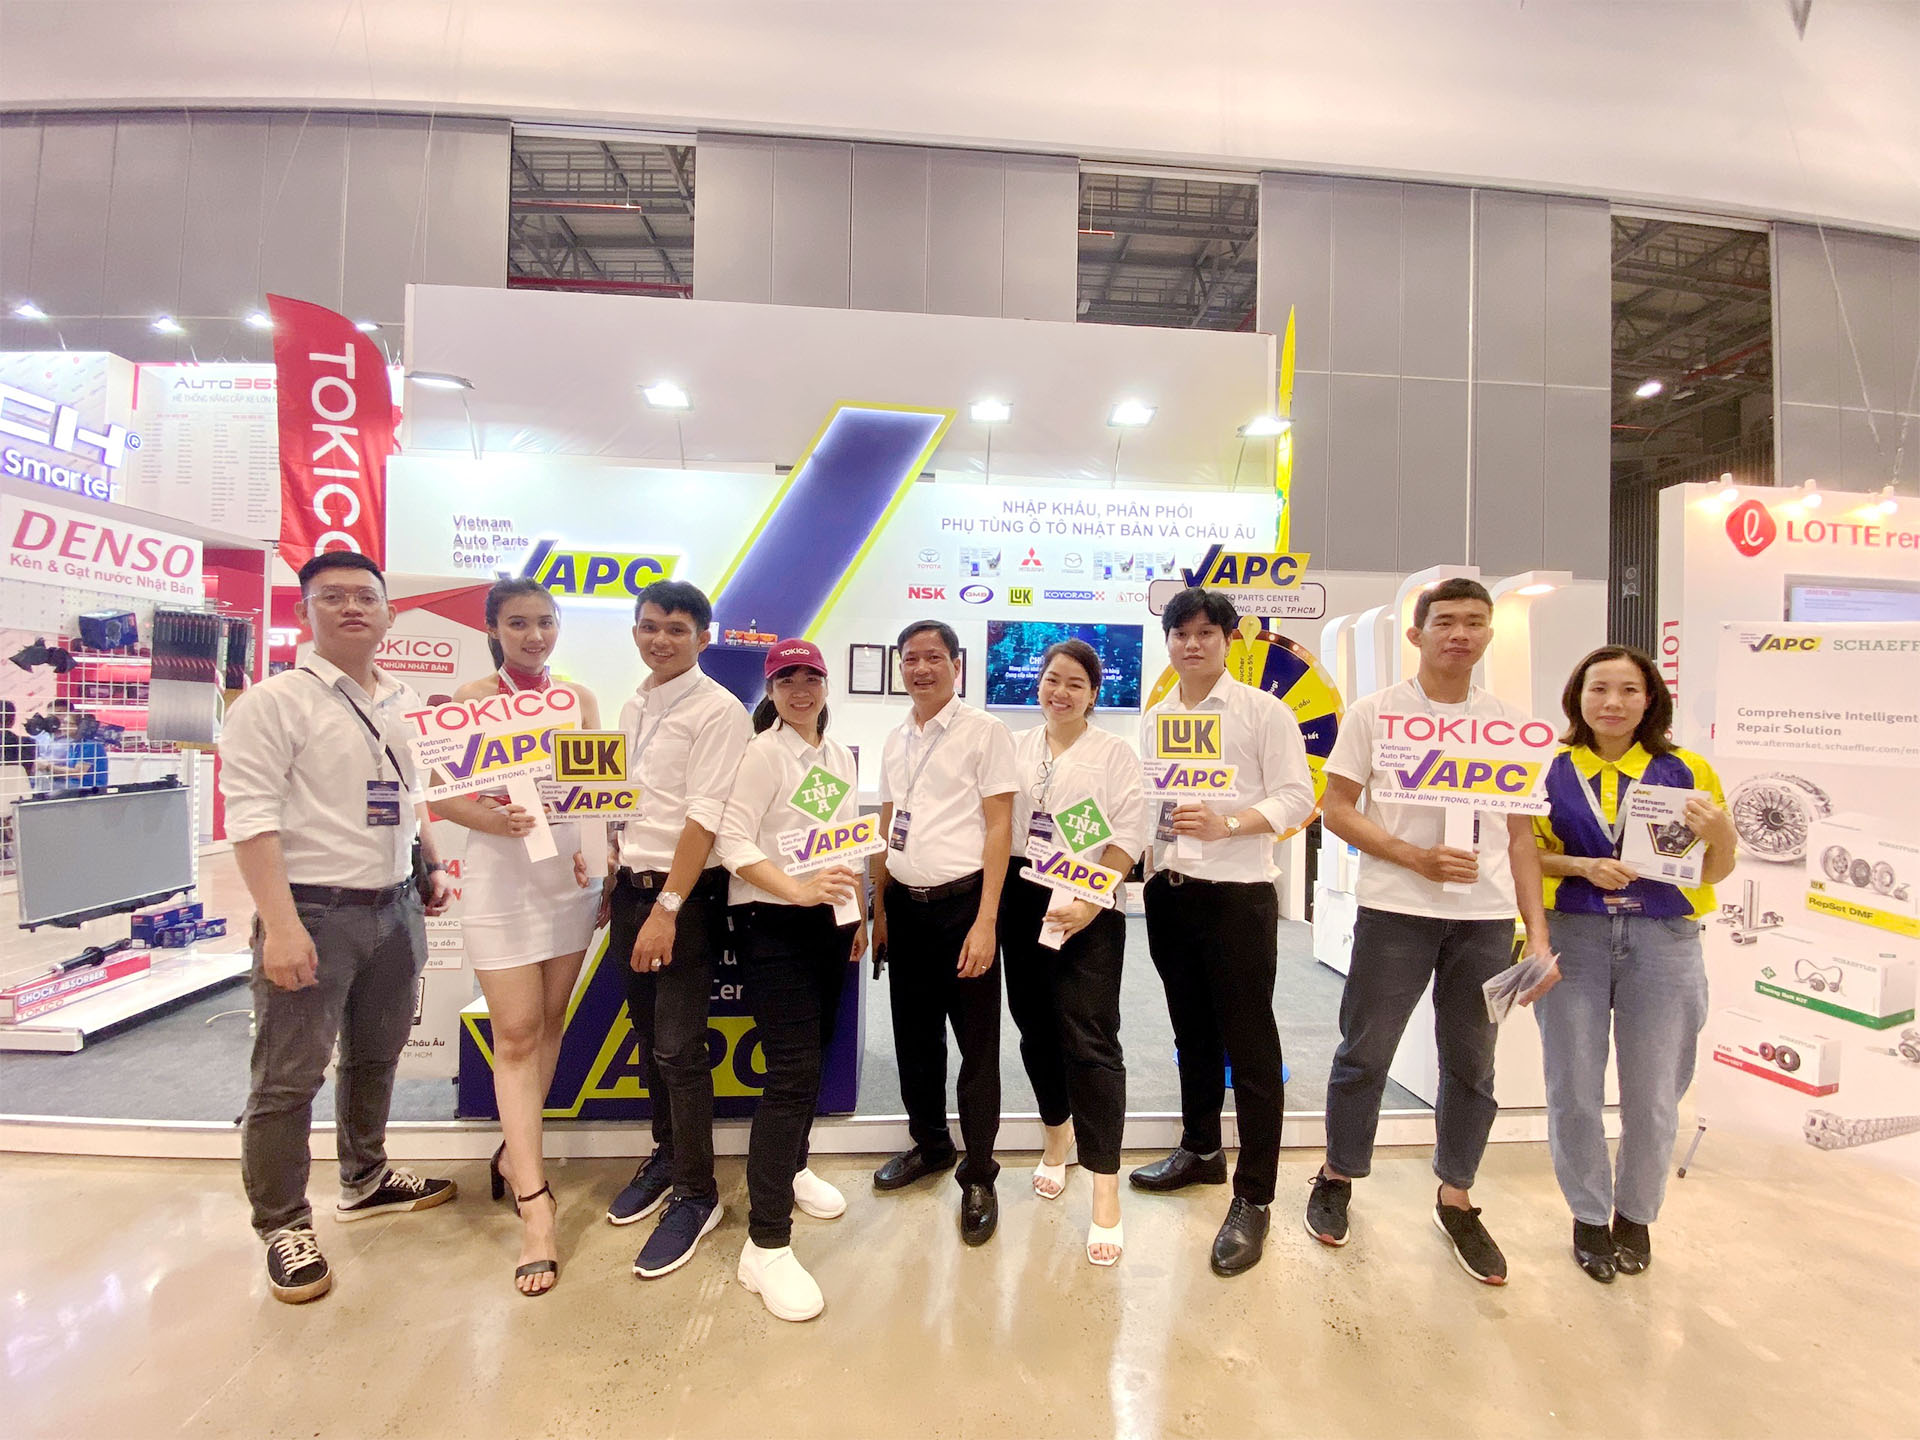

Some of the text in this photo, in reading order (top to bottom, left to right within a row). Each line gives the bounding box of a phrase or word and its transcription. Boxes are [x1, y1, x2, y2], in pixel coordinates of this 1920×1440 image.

[4, 448, 122, 501] Smarter
[1106, 501, 1150, 518] PHÂN
[452, 515, 512, 531] Vietnam
[941, 515, 1256, 540] PHỤ TÙNG Ô TÔ NHẬT BẢN VÀ CHÂU ÂU
[453, 533, 529, 548] Auto Parts
[1787, 519, 1880, 547] LOTTE
[12, 509, 195, 579] DENSO
[452, 551, 501, 566] Center
[10, 553, 194, 595] Kèn & Gạt nước Nhật Bản
[908, 586, 946, 600] NSK
[1010, 589, 1031, 604] LUK
[1045, 591, 1092, 599] KOYORAD
[1238, 594, 1265, 602] PARTS
[1266, 595, 1300, 603] CENTER
[1287, 606, 1316, 614] TP.HCM
[779, 647, 810, 657] TOKICO
[404, 688, 575, 736] TOKICO
[1737, 707, 1919, 724] Comprehensive Intelligent
[1162, 719, 1217, 754] LUK
[1378, 714, 1554, 748] TOKICO
[1737, 722, 1842, 736] Repair Solution
[417, 737, 452, 748] Vietnam
[441, 744, 464, 752] Parts
[1380, 743, 1412, 752] Vietnam
[422, 755, 450, 765] Center
[560, 739, 622, 776] LUK
[1379, 752, 1420, 761] Auto Parts
[1379, 760, 1405, 768] Center
[1154, 763, 1227, 788] VAPC
[1396, 749, 1528, 793] VAPC
[553, 786, 633, 813] VAPC
[1510, 801, 1543, 810] TP.HCM
[1632, 797, 1666, 806] Vietnam
[795, 823, 869, 861] VAPC
[1036, 851, 1107, 890] VAPC
[1808, 896, 1874, 919] RepSet DMF
[18, 968, 106, 1006] SHOCK ABSORBER
[19, 999, 65, 1020] TOKICO
